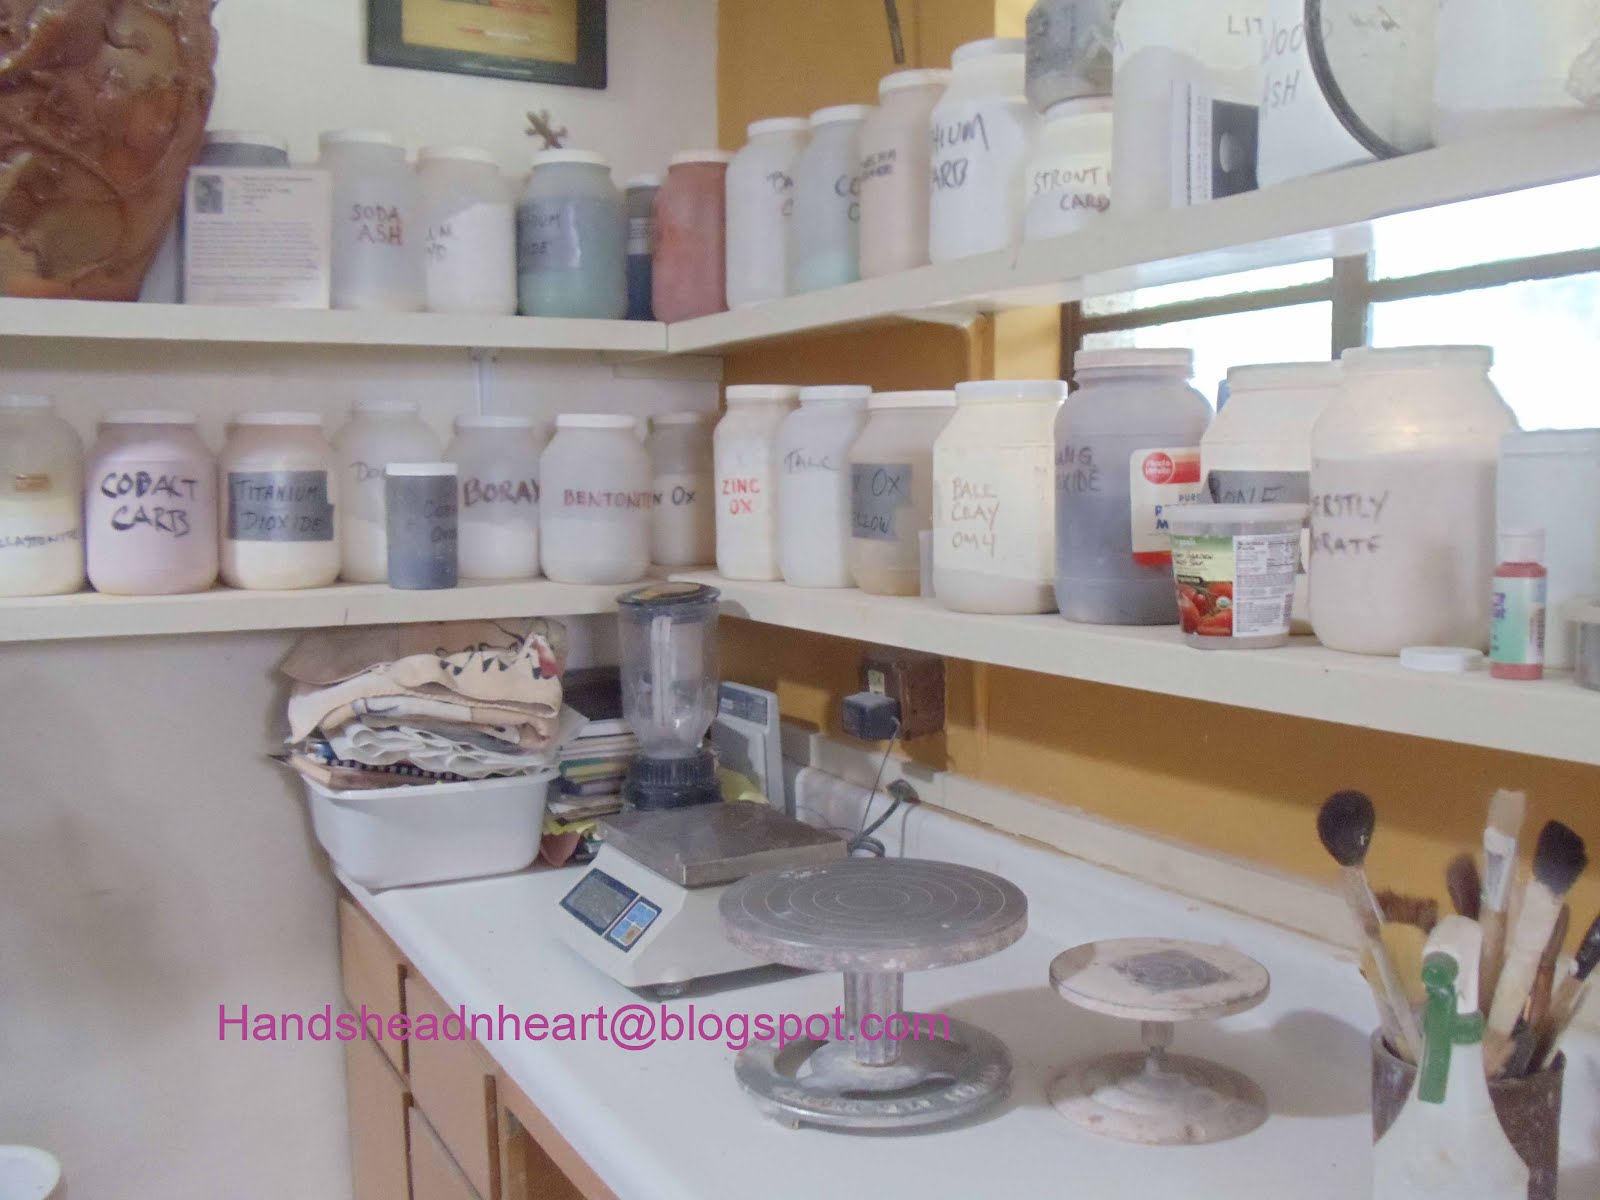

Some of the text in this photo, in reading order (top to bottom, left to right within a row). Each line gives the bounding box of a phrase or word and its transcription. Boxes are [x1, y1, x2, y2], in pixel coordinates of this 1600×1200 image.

[351, 204, 400, 222] SODA
[358, 223, 403, 246] ASH
[722, 478, 760, 495] ZINC
[111, 505, 190, 537] CARB
[952, 501, 1000, 531] CLAY
